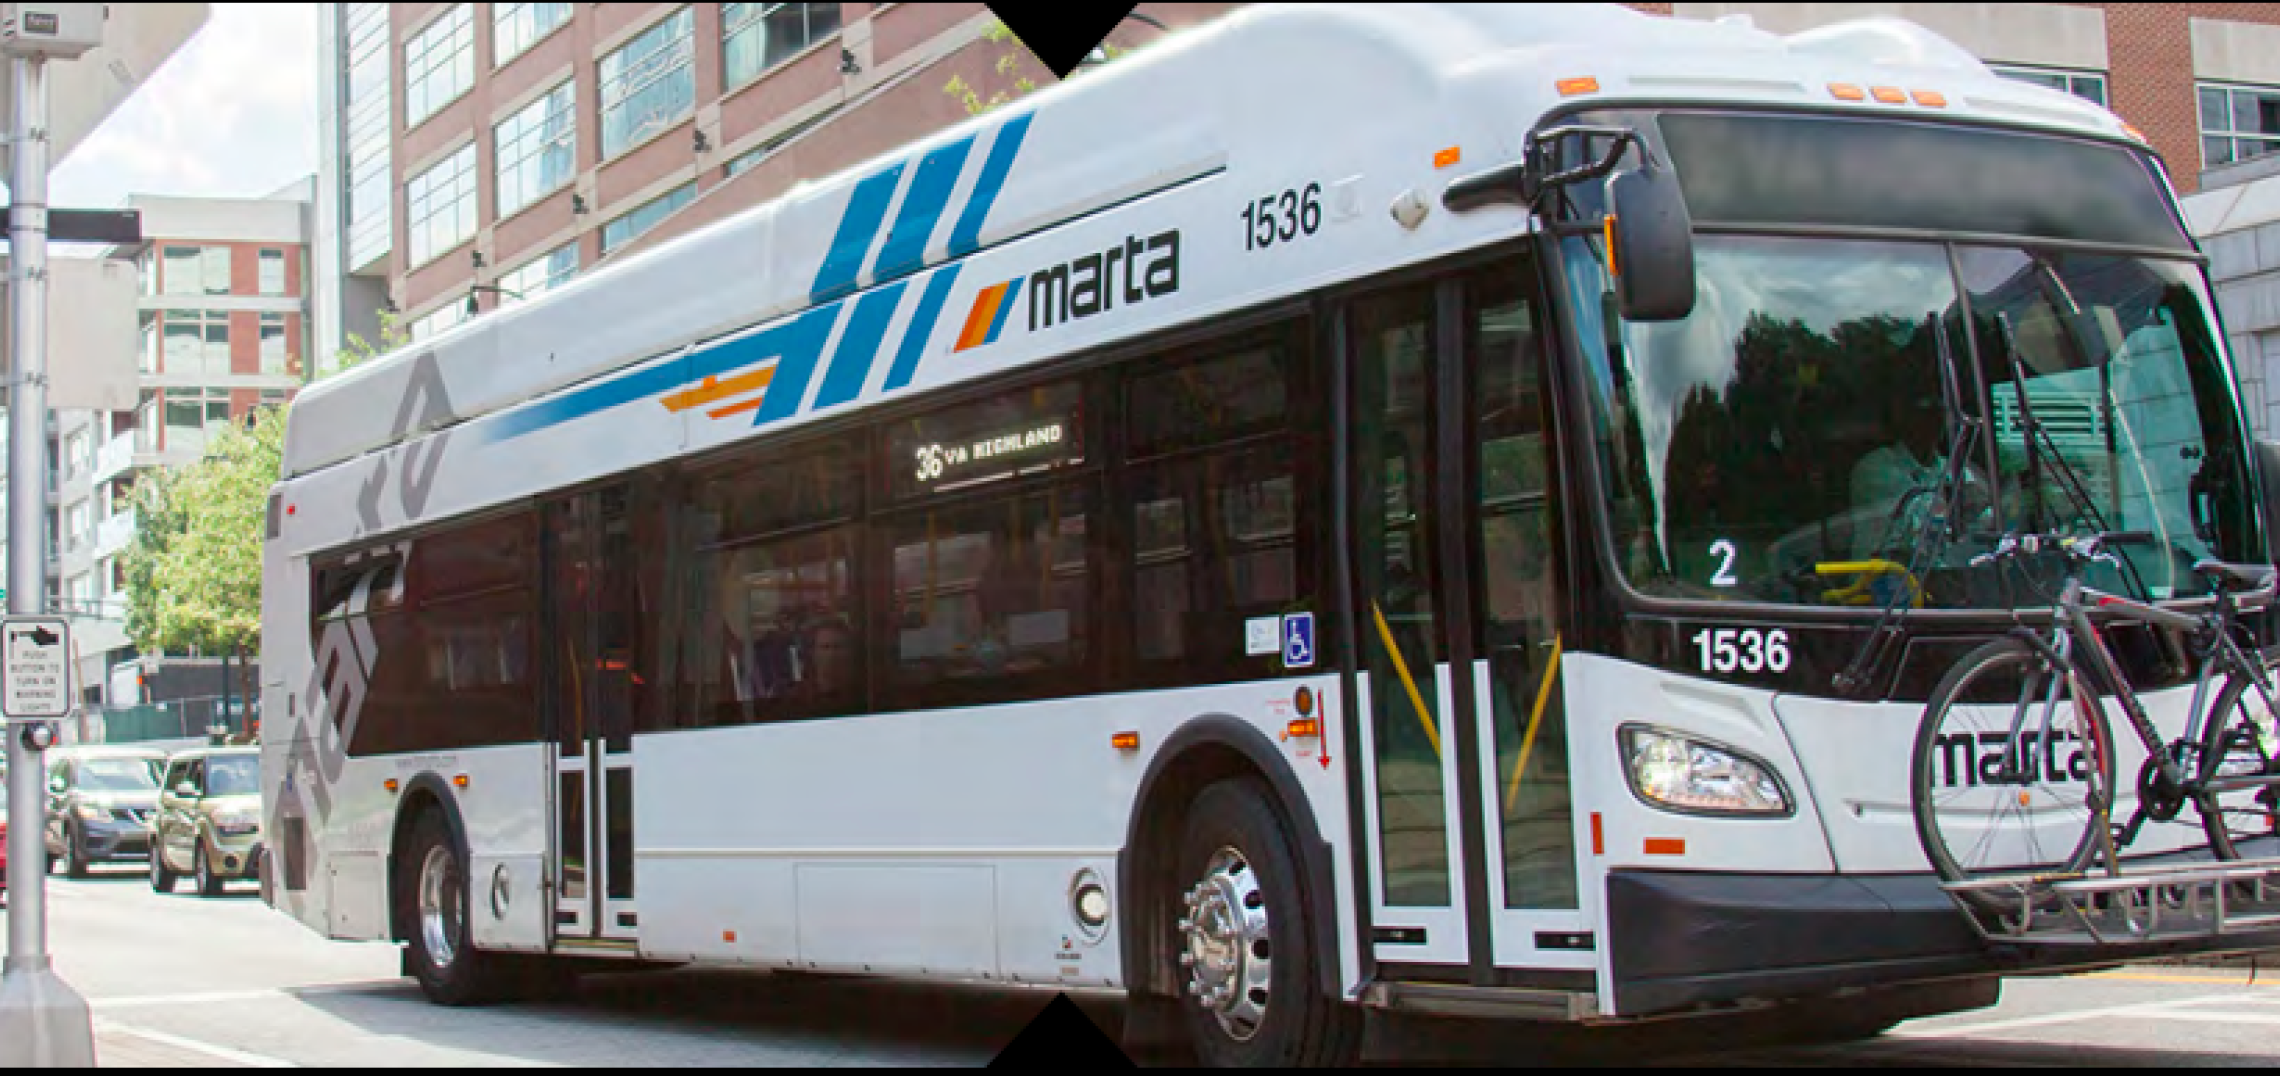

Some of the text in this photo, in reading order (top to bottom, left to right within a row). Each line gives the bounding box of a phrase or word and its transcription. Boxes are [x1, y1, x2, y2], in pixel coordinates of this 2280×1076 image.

[1240, 182, 1322, 251] 1536
[1028, 227, 1181, 332] marta
[915, 444, 944, 482] 36
[973, 424, 1062, 460] HIGHLAND
[1709, 538, 1738, 587] 2
[11, 663, 46, 673] BUTTON
[1692, 627, 1792, 674] 1536
[16, 676, 40, 686] TURN
